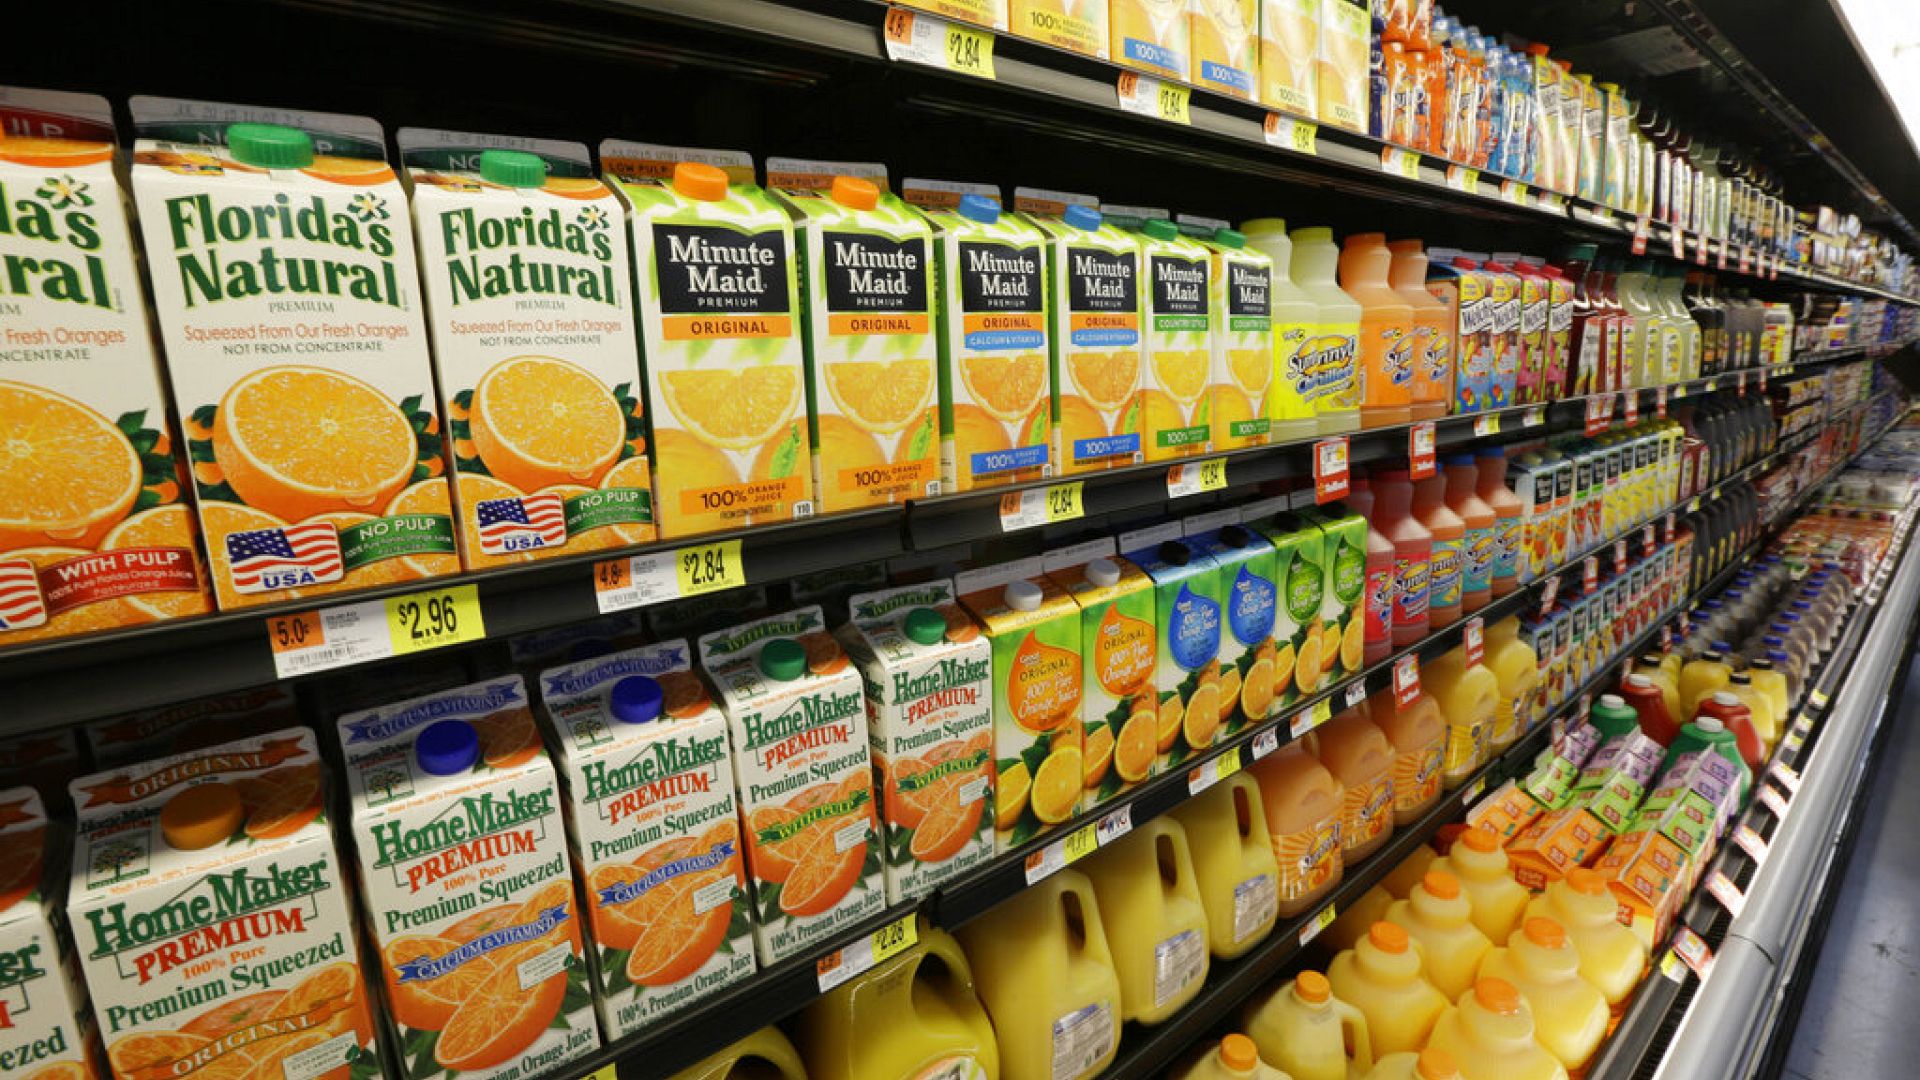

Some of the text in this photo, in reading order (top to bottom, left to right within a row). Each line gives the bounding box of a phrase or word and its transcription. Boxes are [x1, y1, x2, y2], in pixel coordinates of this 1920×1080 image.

[667, 234, 775, 265] Minute
[834, 241, 917, 270] Minute
[968, 250, 1036, 274] Minute
[177, 247, 402, 309] Natural
[1074, 255, 1131, 278] Minute
[1157, 262, 1204, 283] Minute
[447, 253, 616, 306] Natural
[687, 265, 765, 294] Maid
[848, 270, 909, 295] Maid
[980, 274, 1029, 296] Maid
[1085, 277, 1124, 298] Maid
[1166, 281, 1200, 301] Maid
[269, 301, 334, 313] PREMIUM
[515, 300, 565, 311] PREMIUM
[698, 296, 758, 307] PREMIUM
[856, 297, 904, 307] PREMIUM
[1240, 286, 1265, 303] Maid
[184, 323, 409, 343] Squeezed From Our Fresh Oranges
[451, 320, 505, 336] Squeezed
[507, 320, 533, 332] From
[556, 319, 580, 332] Fresh
[582, 319, 622, 334] Oranges
[690, 320, 770, 336] ORIGINAL
[850, 319, 912, 332] ORIGINAL
[983, 317, 1032, 329] ORIGINAL
[1085, 317, 1127, 327] ORIGINAL
[6, 327, 126, 346] Fresh Oranges
[223, 341, 383, 355] NOT FROM CONCENTRATE
[480, 334, 601, 347] NOT FROM CONCENTRATE
[985, 454, 1015, 469] 100%
[855, 469, 891, 487] 100%
[580, 491, 639, 510] NO PULP
[700, 483, 786, 509] 100% ORANGE
[360, 518, 436, 540] NO PULP
[503, 536, 545, 551] USA
[57, 551, 180, 581] WITH PULP
[683, 548, 725, 585] $2.84
[263, 571, 316, 589] USA
[398, 597, 457, 640] $2.96
[893, 657, 989, 706] HomeMaker
[1020, 658, 1069, 683] ORIGINAL
[908, 687, 976, 726] PREMIUM
[742, 691, 863, 752] HomeMaker
[765, 724, 848, 772] PREMIUM
[894, 728, 941, 753] Premium
[129, 754, 264, 799] ORIGINAL
[581, 735, 725, 802] HomeMaker
[750, 744, 867, 803] Premium Squeezed
[608, 771, 711, 826] PREMIUM
[370, 788, 555, 866] HomeMaker
[591, 794, 733, 862] Premium Squeezed
[407, 830, 537, 894] PREMIUM
[443, 863, 507, 892] 100% Pure
[384, 852, 565, 934] Premium Squeezed
[85, 859, 328, 957] HomeMaker
[134, 907, 307, 986] PREMIUM
[183, 945, 268, 980] 100% Pure
[105, 933, 345, 1033] Premium Squeezed
[649, 984, 694, 1013] Premium
[695, 967, 728, 991] Orange
[729, 952, 751, 974] Juice
[172, 1015, 317, 1076] ORIGINAL
[522, 1027, 592, 1073] Orange Juice
